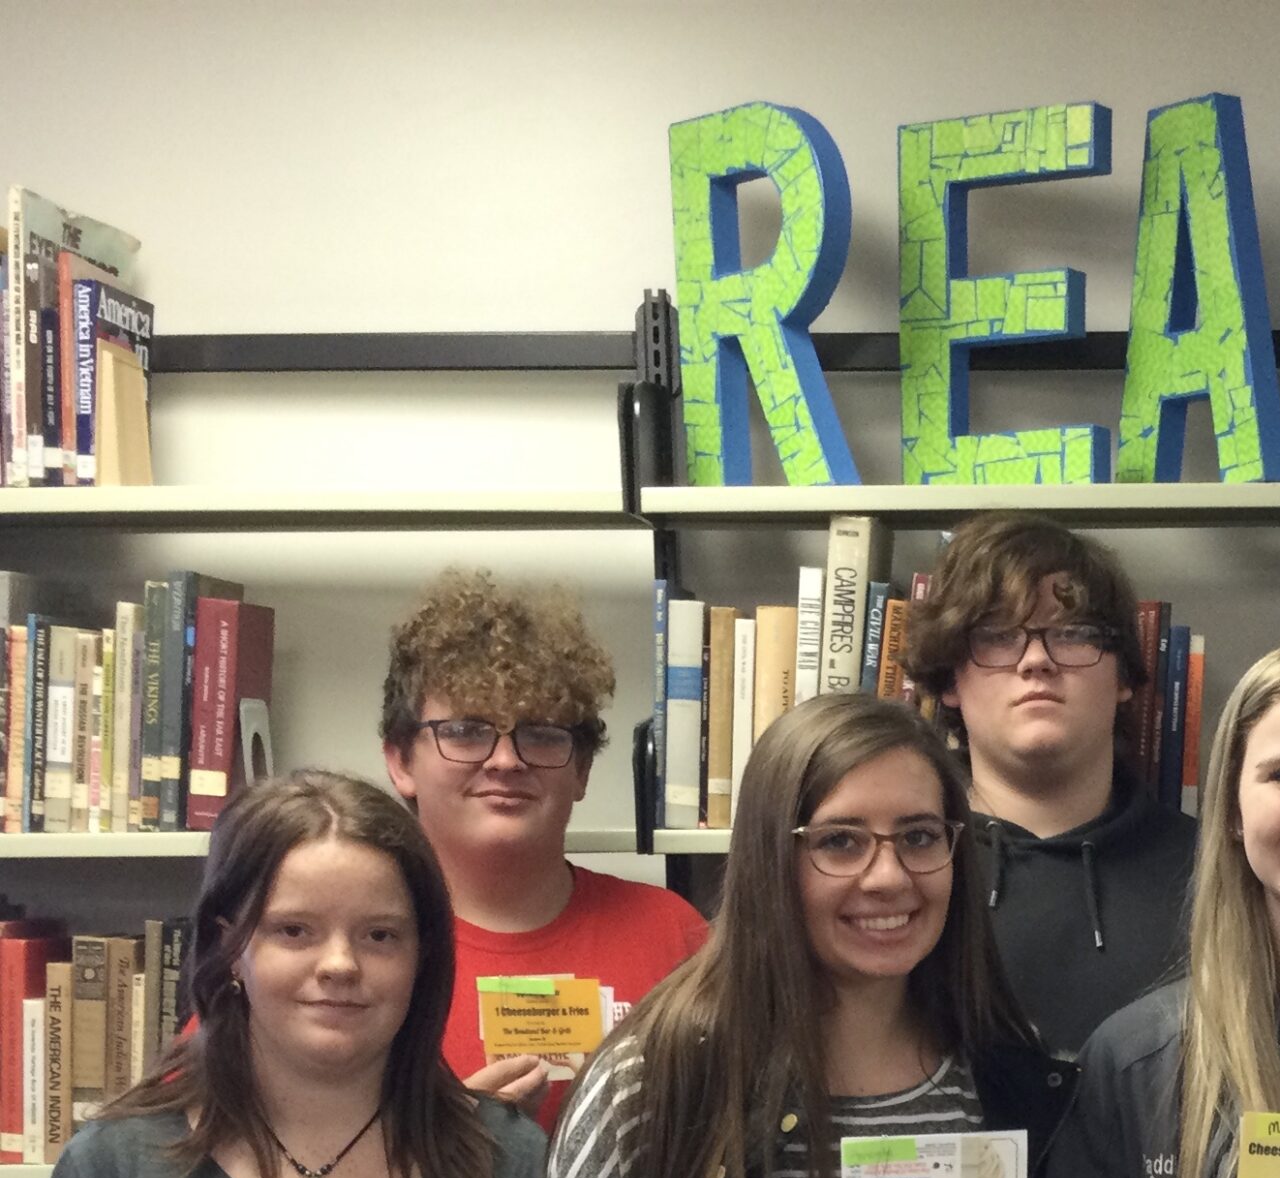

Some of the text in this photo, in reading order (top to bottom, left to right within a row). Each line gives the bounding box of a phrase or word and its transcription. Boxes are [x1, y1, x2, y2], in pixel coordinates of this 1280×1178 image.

[97, 285, 151, 340] America
[78, 284, 95, 415] America in Vietnam
[829, 567, 858, 654] CAMPFIRES
[870, 608, 883, 640] CIVIL
[145, 640, 160, 725] THE VIKINGS
[865, 643, 879, 667] WAR
[568, 1006, 590, 1016] Fries
[48, 985, 61, 1144] THE AMERICAN INDIAN
